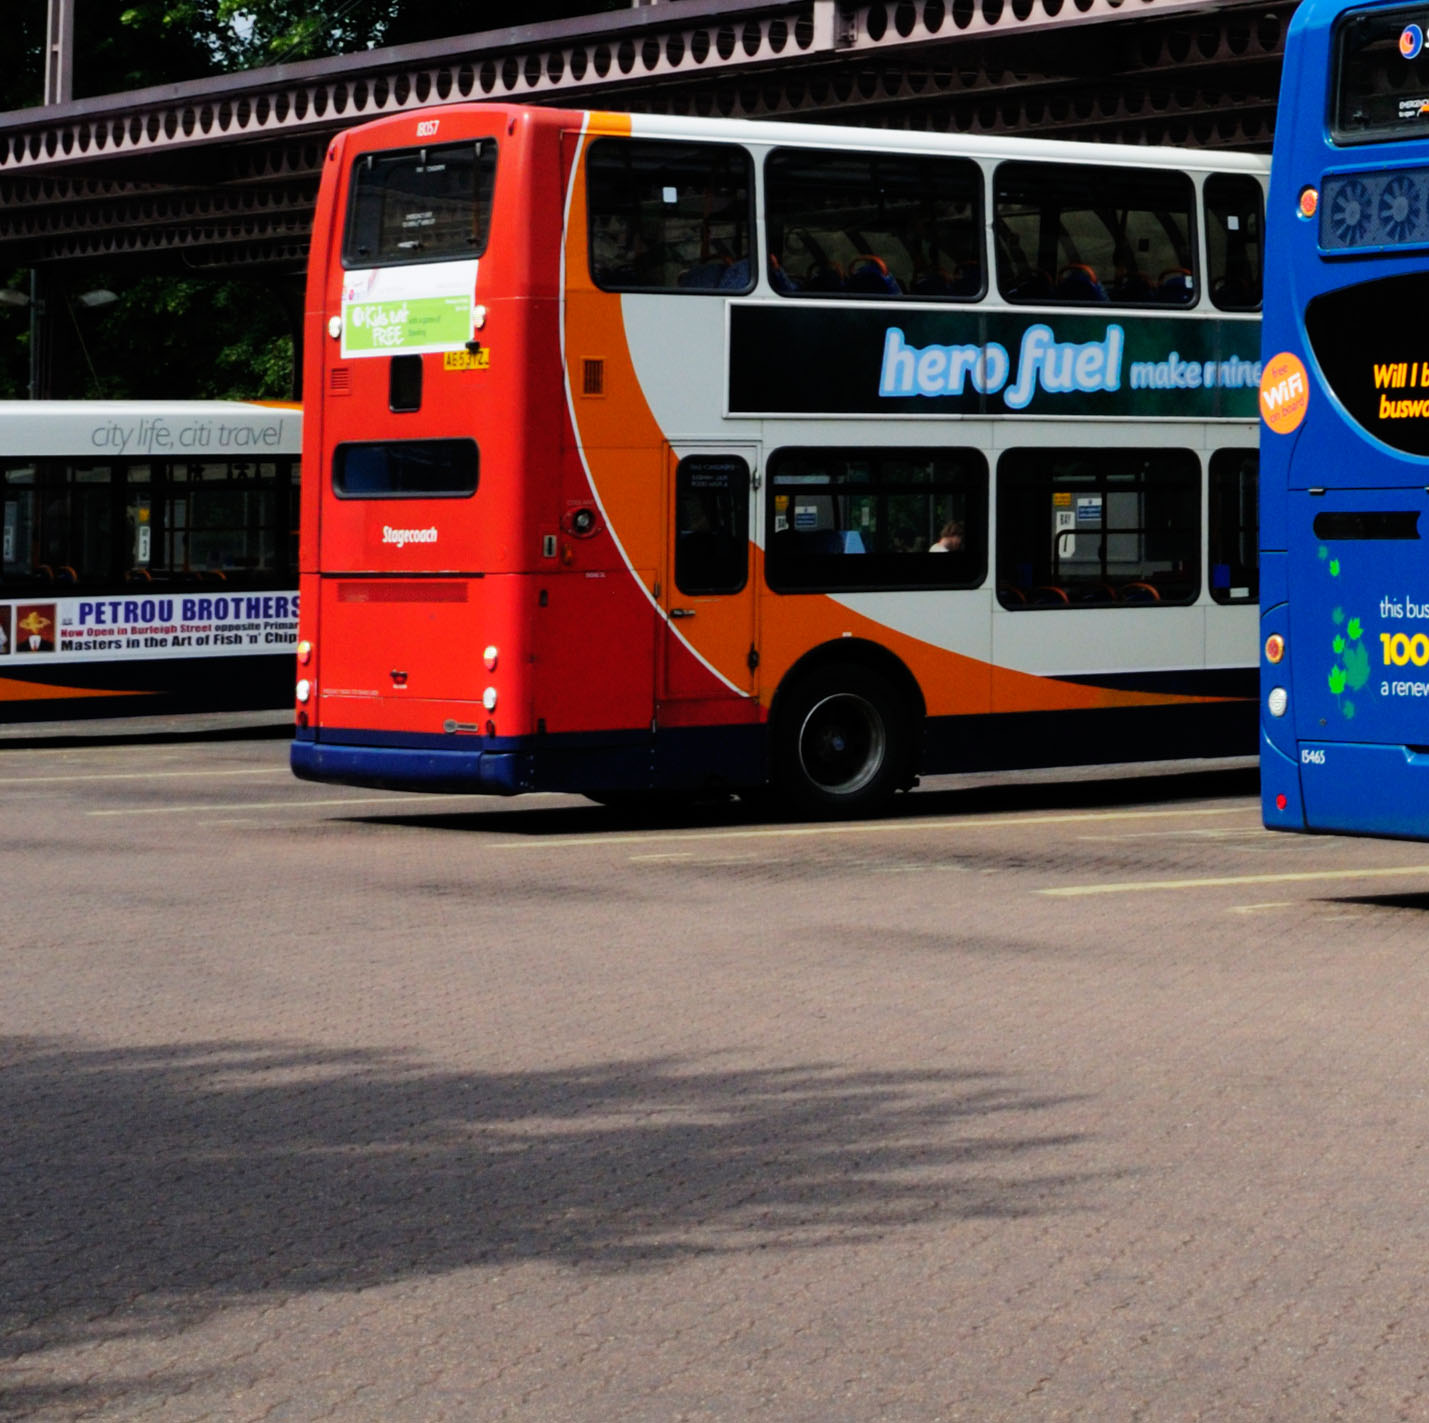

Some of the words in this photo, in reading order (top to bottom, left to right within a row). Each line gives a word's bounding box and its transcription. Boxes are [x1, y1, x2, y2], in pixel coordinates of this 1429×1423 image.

[879, 326, 1009, 398] hero
[1003, 323, 1125, 409] fuel
[1130, 351, 1202, 390] make
[1203, 354, 1262, 390] mine
[1373, 362, 1408, 389] Will
[1410, 363, 1419, 388] I
[1262, 372, 1303, 410] WiFi
[91, 420, 134, 455] city
[136, 418, 174, 453] life,
[179, 420, 212, 447] citi
[218, 419, 284, 447] travel
[382, 525, 438, 548] Stagecoach
[79, 599, 174, 625] PETROU
[182, 595, 299, 622] BROTHERS
[1379, 595, 1403, 618] this
[61, 629, 84, 637] Now
[87, 627, 114, 637] Open
[117, 627, 127, 635] in
[131, 624, 177, 636] Burleigh
[180, 623, 212, 633] Street
[214, 622, 261, 632] opposite
[61, 639, 122, 652] Masters
[126, 638, 140, 649] in
[144, 636, 168, 648] the
[172, 635, 192, 647] Art
[196, 634, 209, 646] of
[213, 633, 242, 645] Fish
[1380, 680, 1389, 696] a
[1301, 749, 1325, 765] 15465
